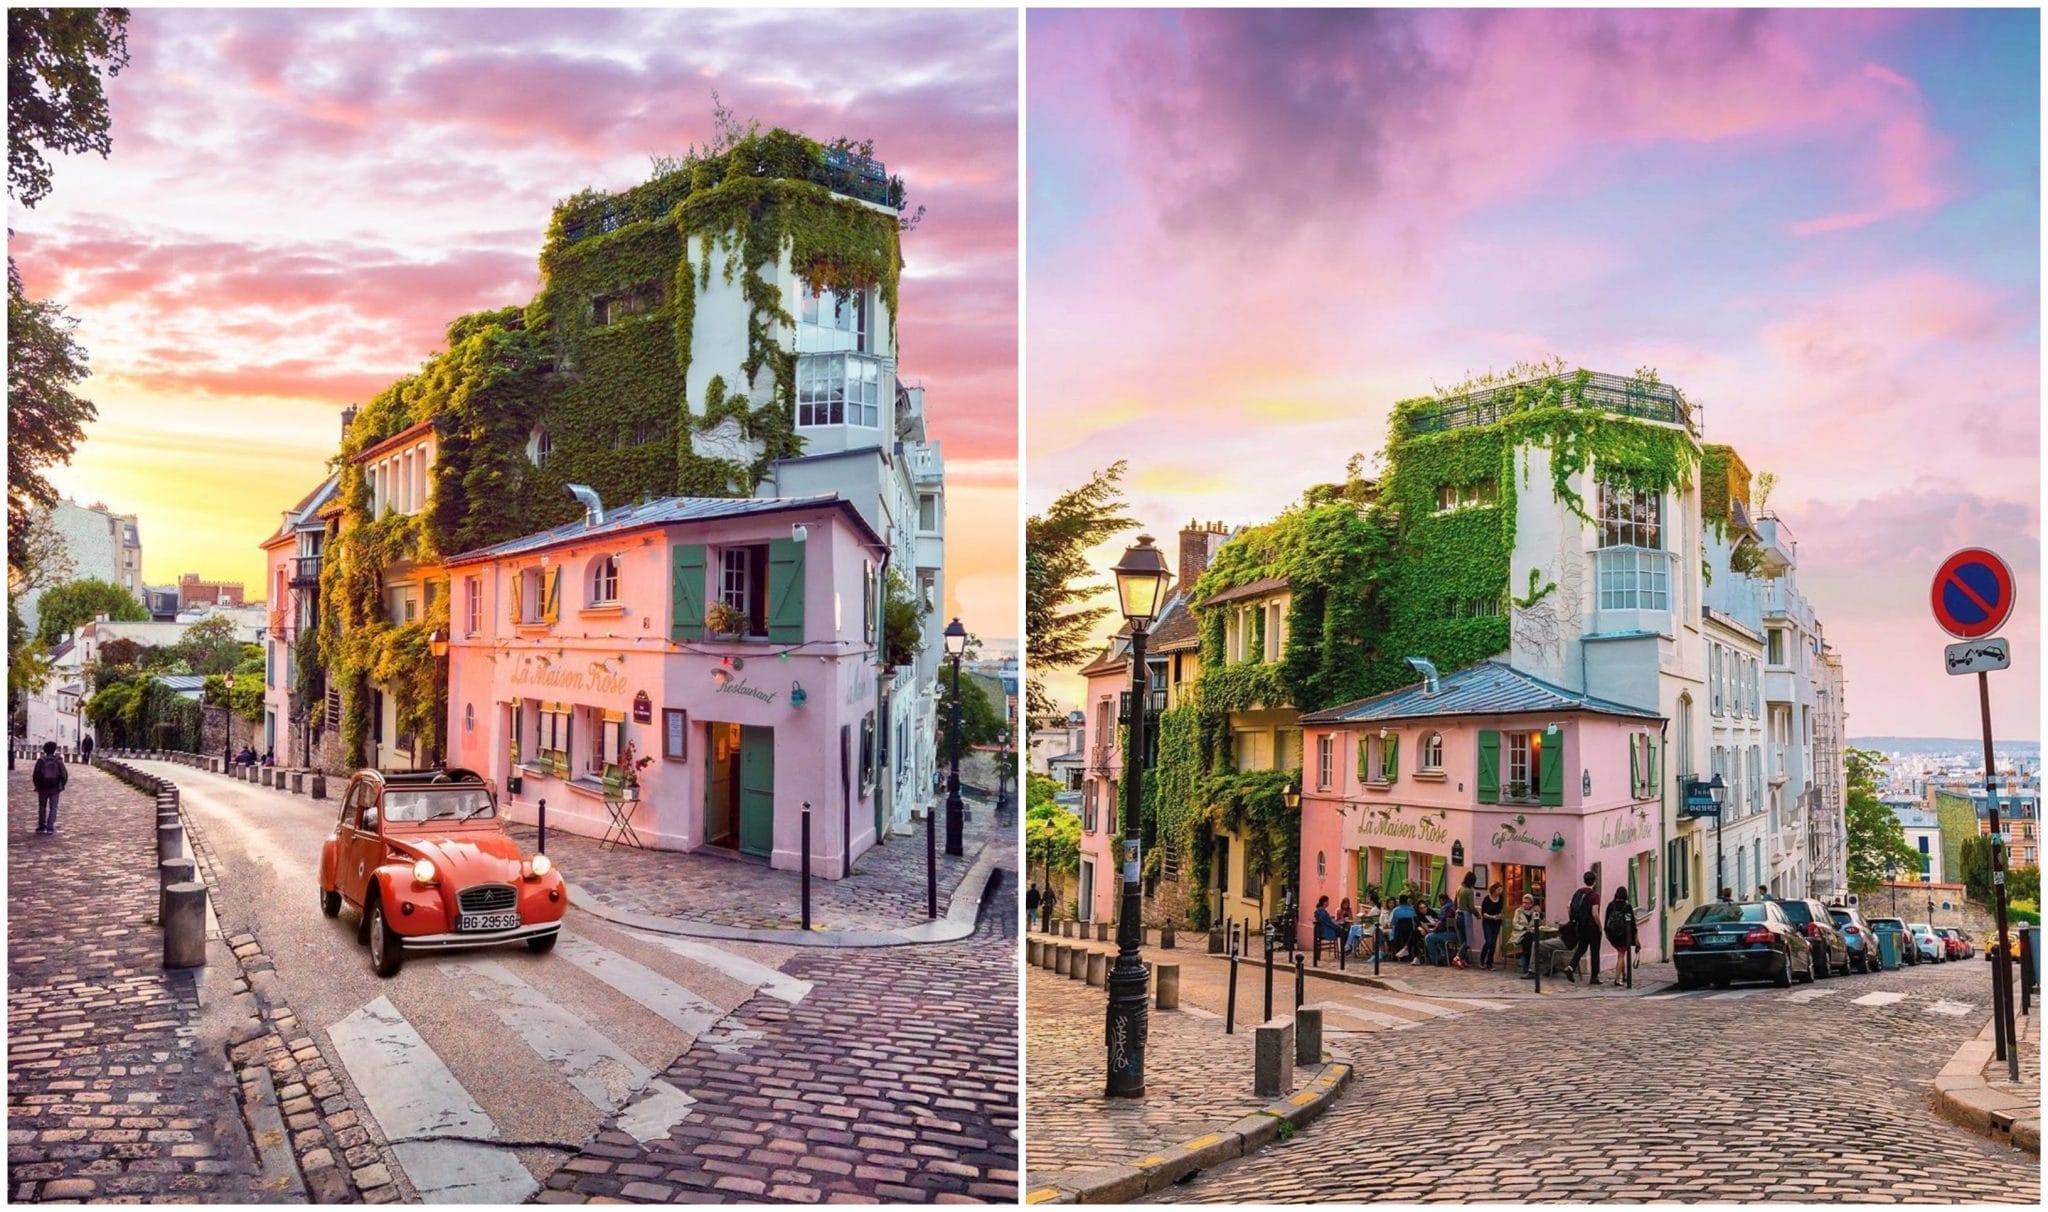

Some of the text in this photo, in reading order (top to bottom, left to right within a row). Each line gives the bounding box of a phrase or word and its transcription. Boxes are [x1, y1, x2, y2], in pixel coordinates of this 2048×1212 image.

[511, 652, 626, 694] La Maison Rose
[716, 678, 776, 704] Restaurant
[1358, 807, 1447, 844] La Maison Rose
[1600, 816, 1610, 849] La
